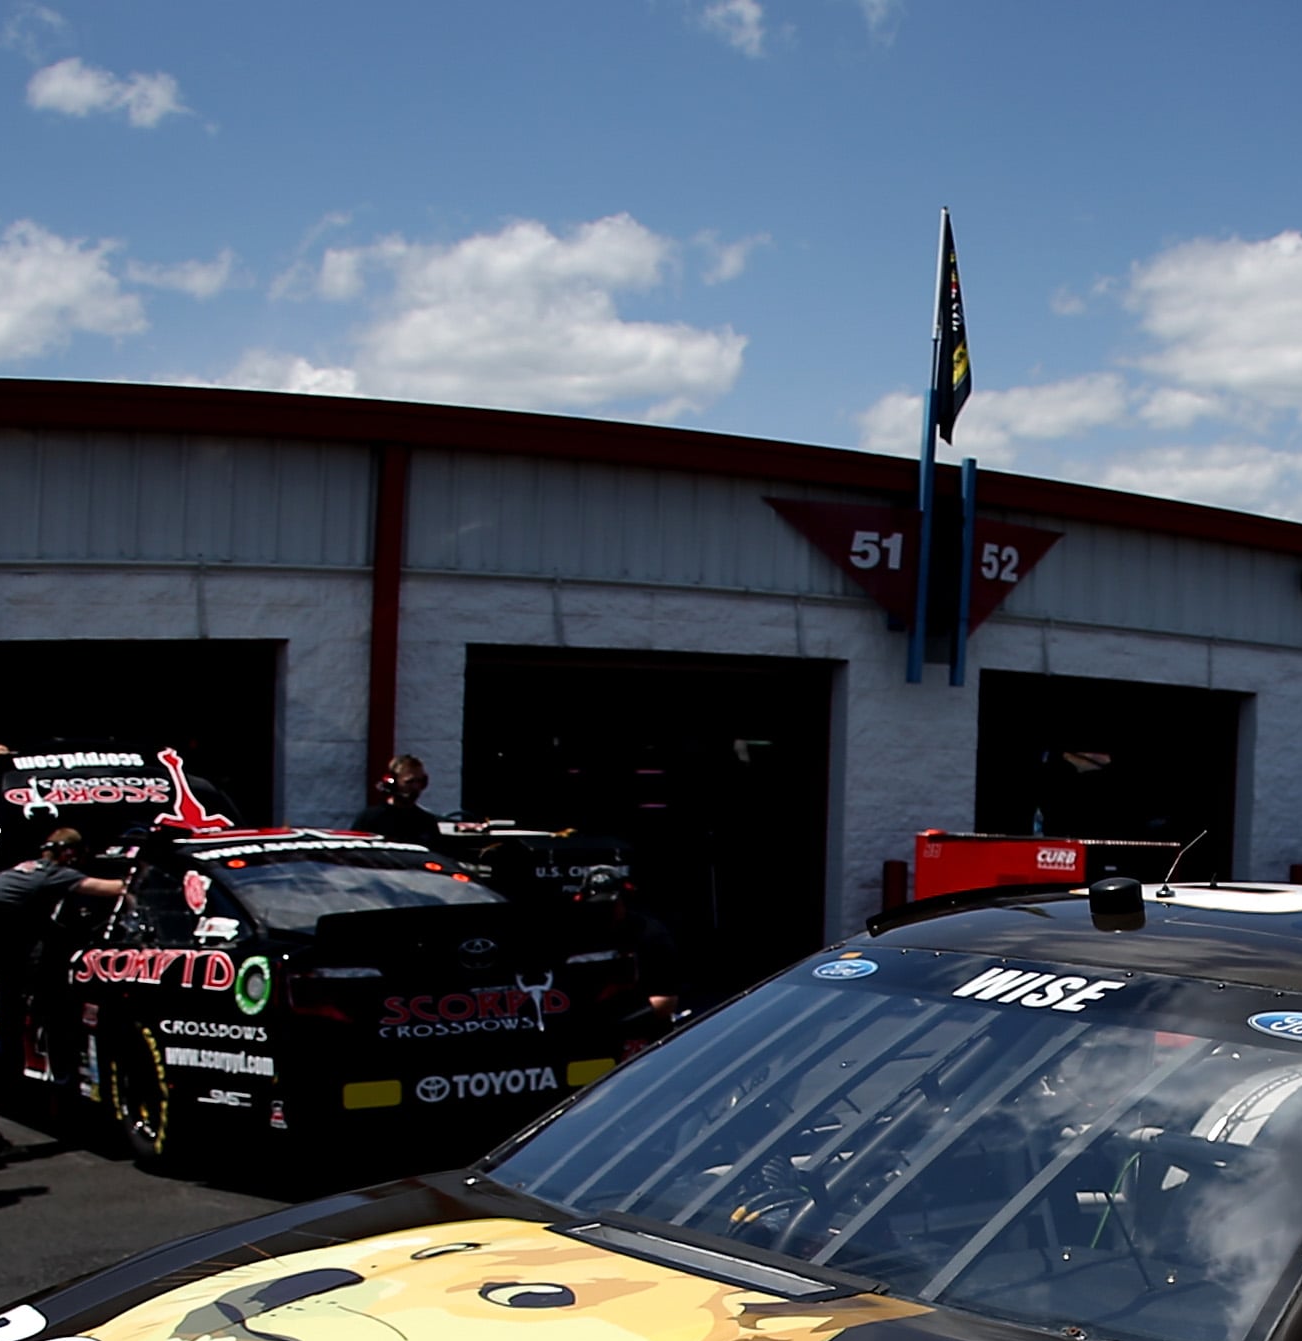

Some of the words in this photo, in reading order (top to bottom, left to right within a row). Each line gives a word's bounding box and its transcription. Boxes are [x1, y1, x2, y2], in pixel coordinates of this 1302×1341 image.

[849, 530, 903, 570] 51
[981, 542, 1019, 582] 52
[1036, 847, 1077, 865] CURB
[951, 965, 1126, 1013] WISE
[451, 1065, 559, 1100] TOYOTA
